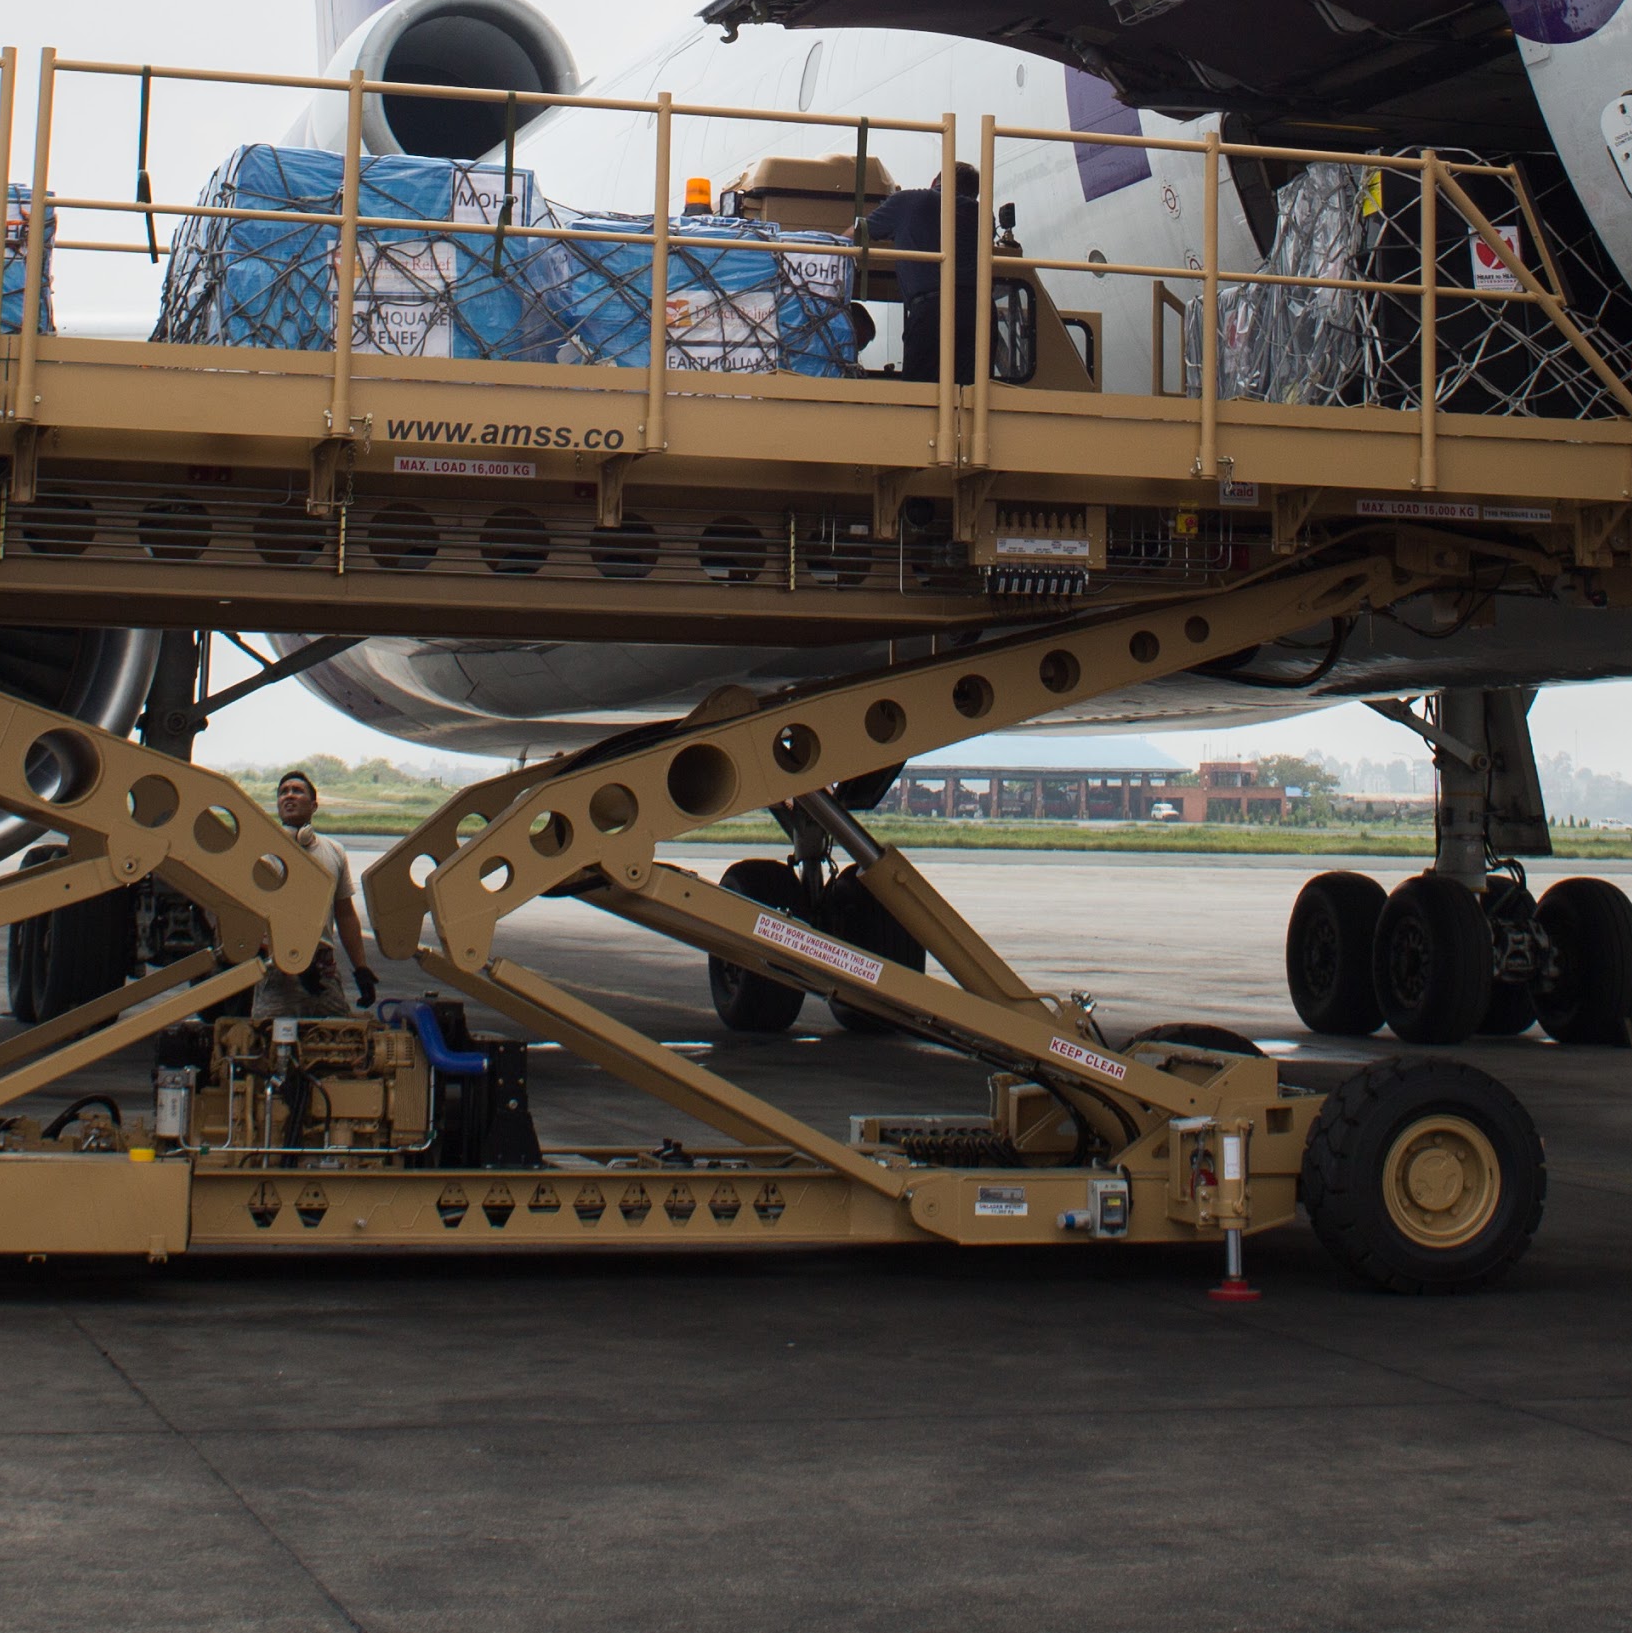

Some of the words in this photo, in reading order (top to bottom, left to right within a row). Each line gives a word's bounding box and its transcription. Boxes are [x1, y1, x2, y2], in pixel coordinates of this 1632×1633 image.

[787, 260, 839, 280] MOHP
[387, 419, 624, 450] www.amss.co
[400, 459, 430, 472] MAX.
[434, 460, 467, 473] LOAD
[471, 462, 509, 476] 16,000
[513, 464, 530, 476] KG
[1361, 502, 1388, 513] MAX.
[1391, 503, 1420, 514] LOAD
[1424, 504, 1456, 517] 16,000
[1459, 506, 1475, 517] KG
[757, 927, 783, 943] UNLESS
[783, 936, 791, 945] IT
[791, 939, 799, 949] IS
[799, 943, 849, 969] MECHANICALLY
[849, 964, 876, 981] LOCKED
[759, 916, 770, 926] DO
[771, 920, 785, 932] NOT
[787, 927, 806, 941] WORK
[806, 933, 849, 959] UNDERNEATH
[850, 953, 865, 966] THIS
[866, 960, 880, 972] LIFT
[1051, 1039, 1083, 1059] KEEP
[1085, 1053, 1124, 1078] CLEAR
